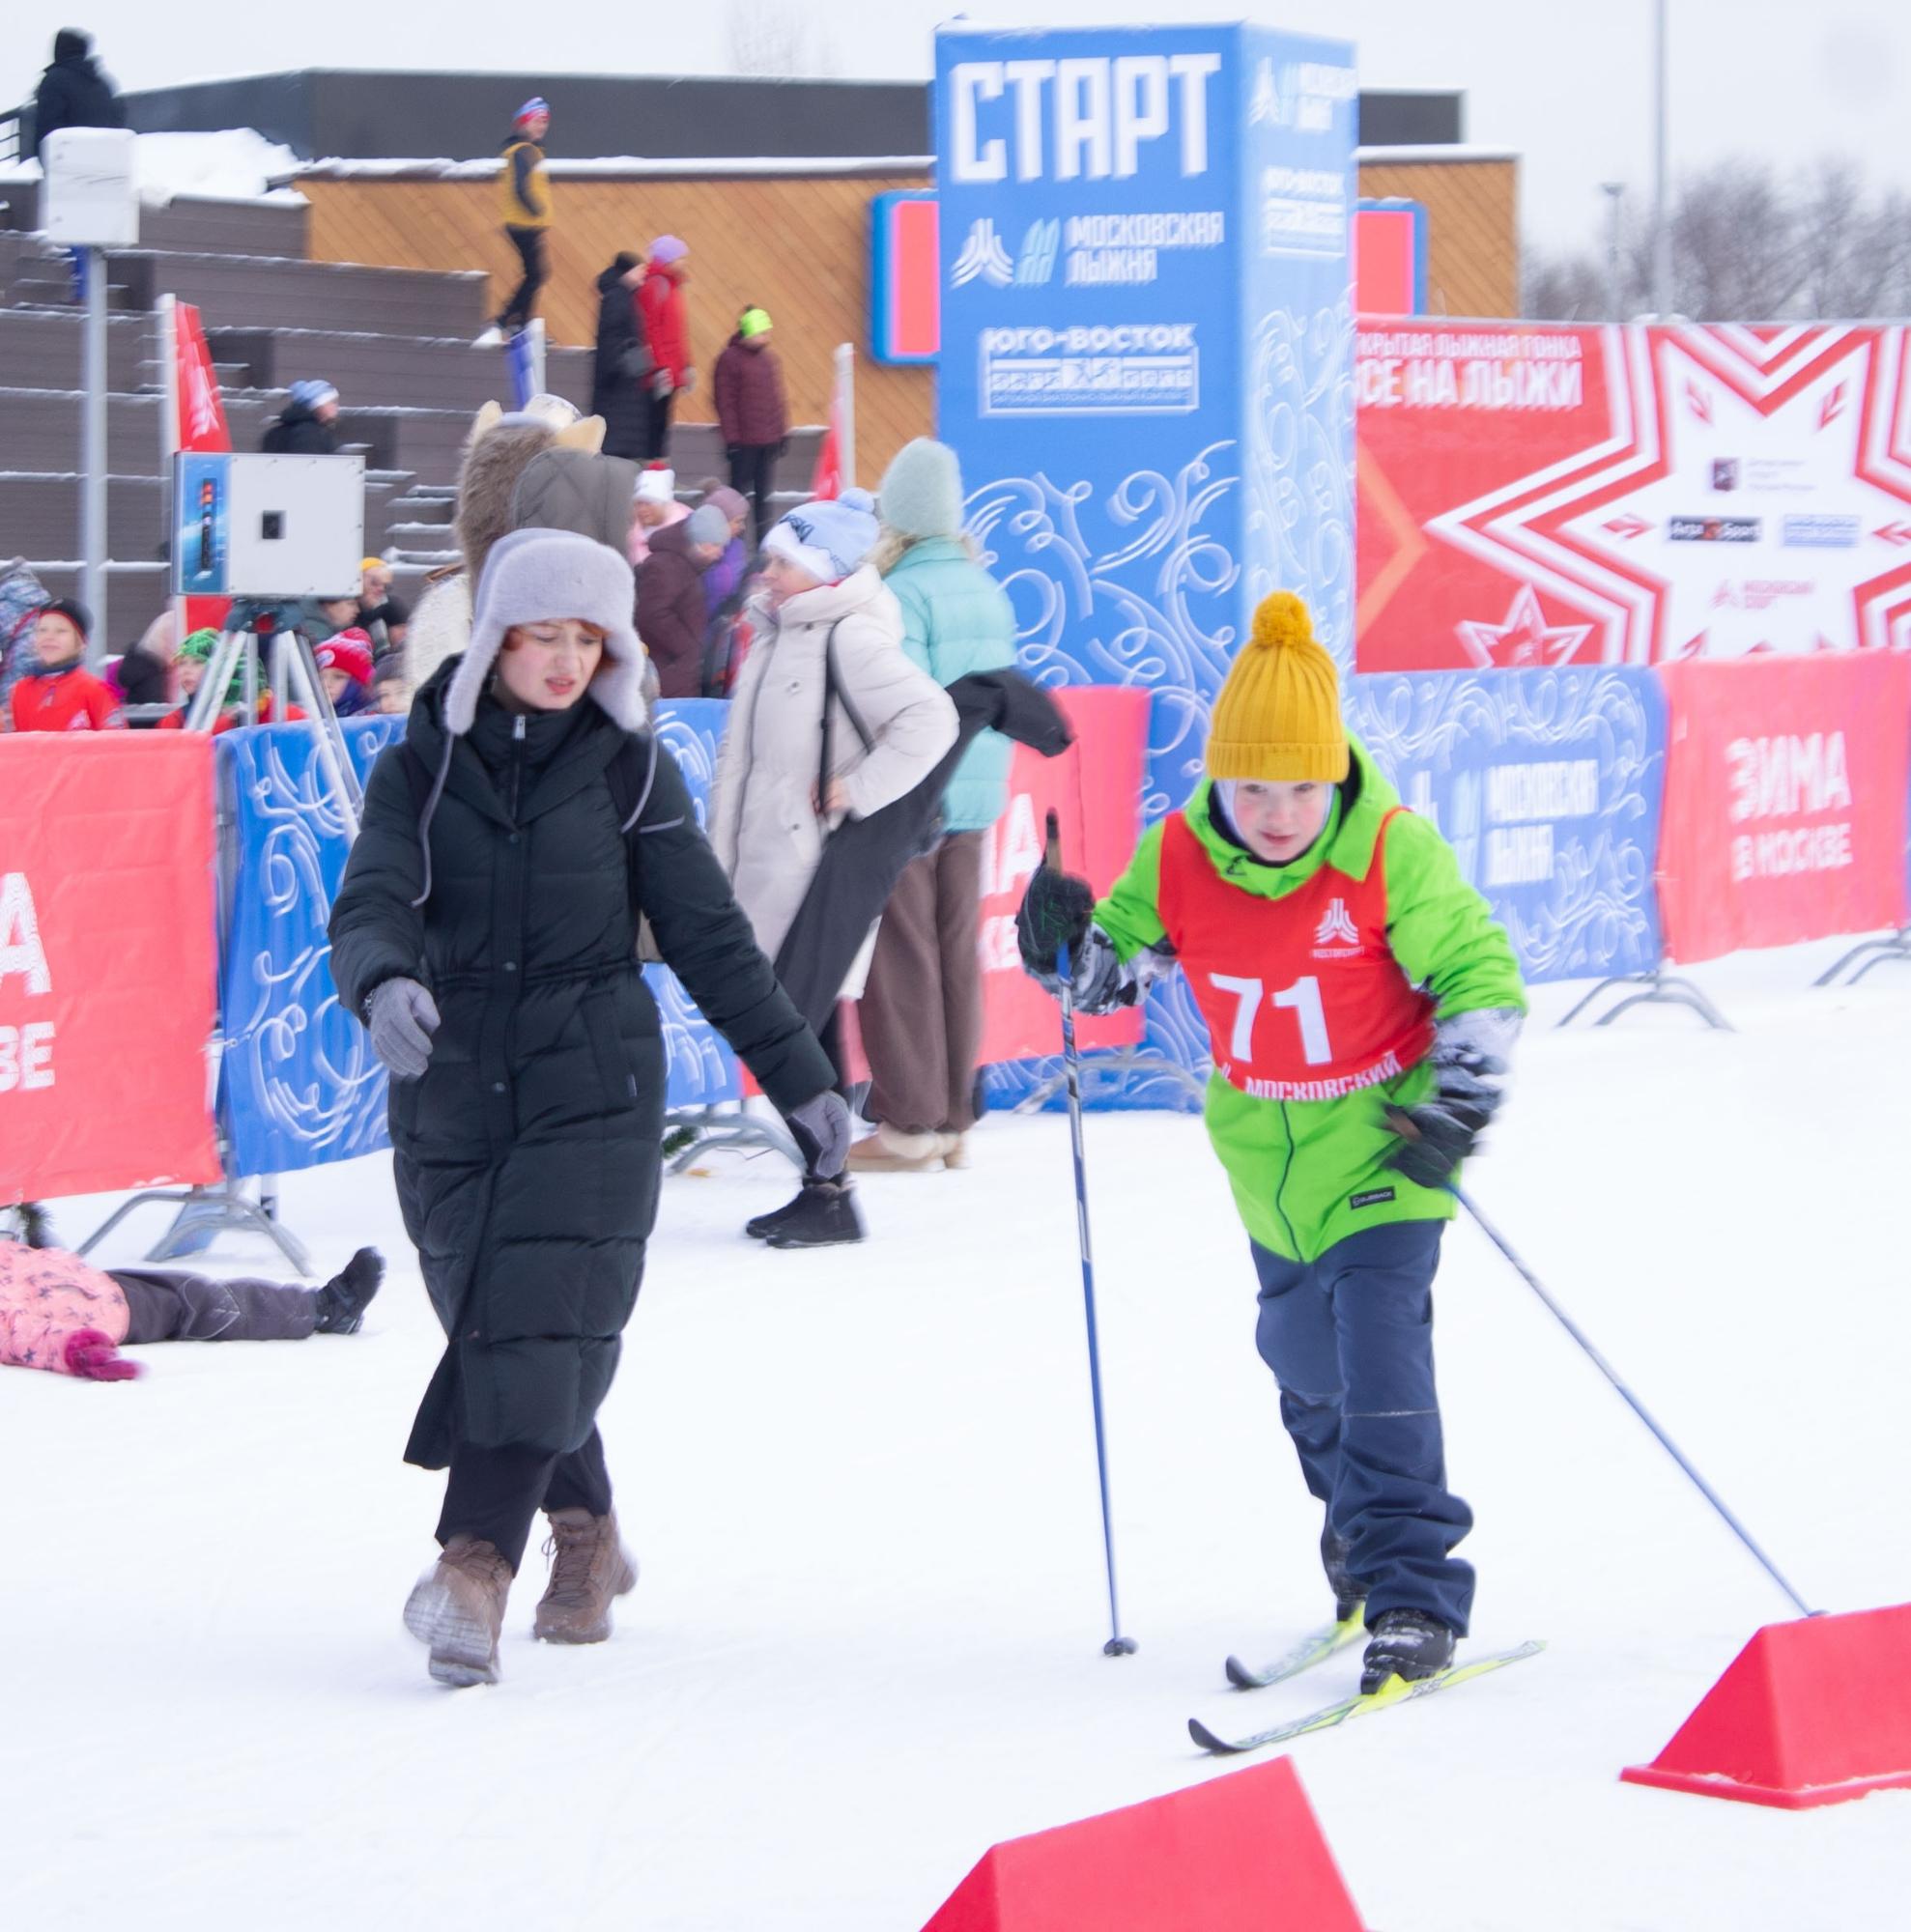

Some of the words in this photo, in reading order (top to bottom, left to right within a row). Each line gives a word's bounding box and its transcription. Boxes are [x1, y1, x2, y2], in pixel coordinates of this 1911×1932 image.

[951, 53, 1221, 184] СТАРТ
[1067, 212, 1224, 247] МОСКОВСКАЯ
[1066, 249, 1158, 286] ЛЫЖНЯ
[984, 324, 1198, 354] ЮГО-ВОСТОК
[1436, 333, 1518, 357] ЛЫЖНАЯ
[1524, 334, 1583, 358] ГОНКА
[1405, 359, 1458, 408] НА
[1462, 360, 1583, 410] ЛЫЖИ
[1726, 731, 1852, 822] ЗИМА
[1732, 835, 1754, 882] В
[1756, 823, 1853, 877] МОСКВЕ
[1210, 973, 1331, 1065] 71
